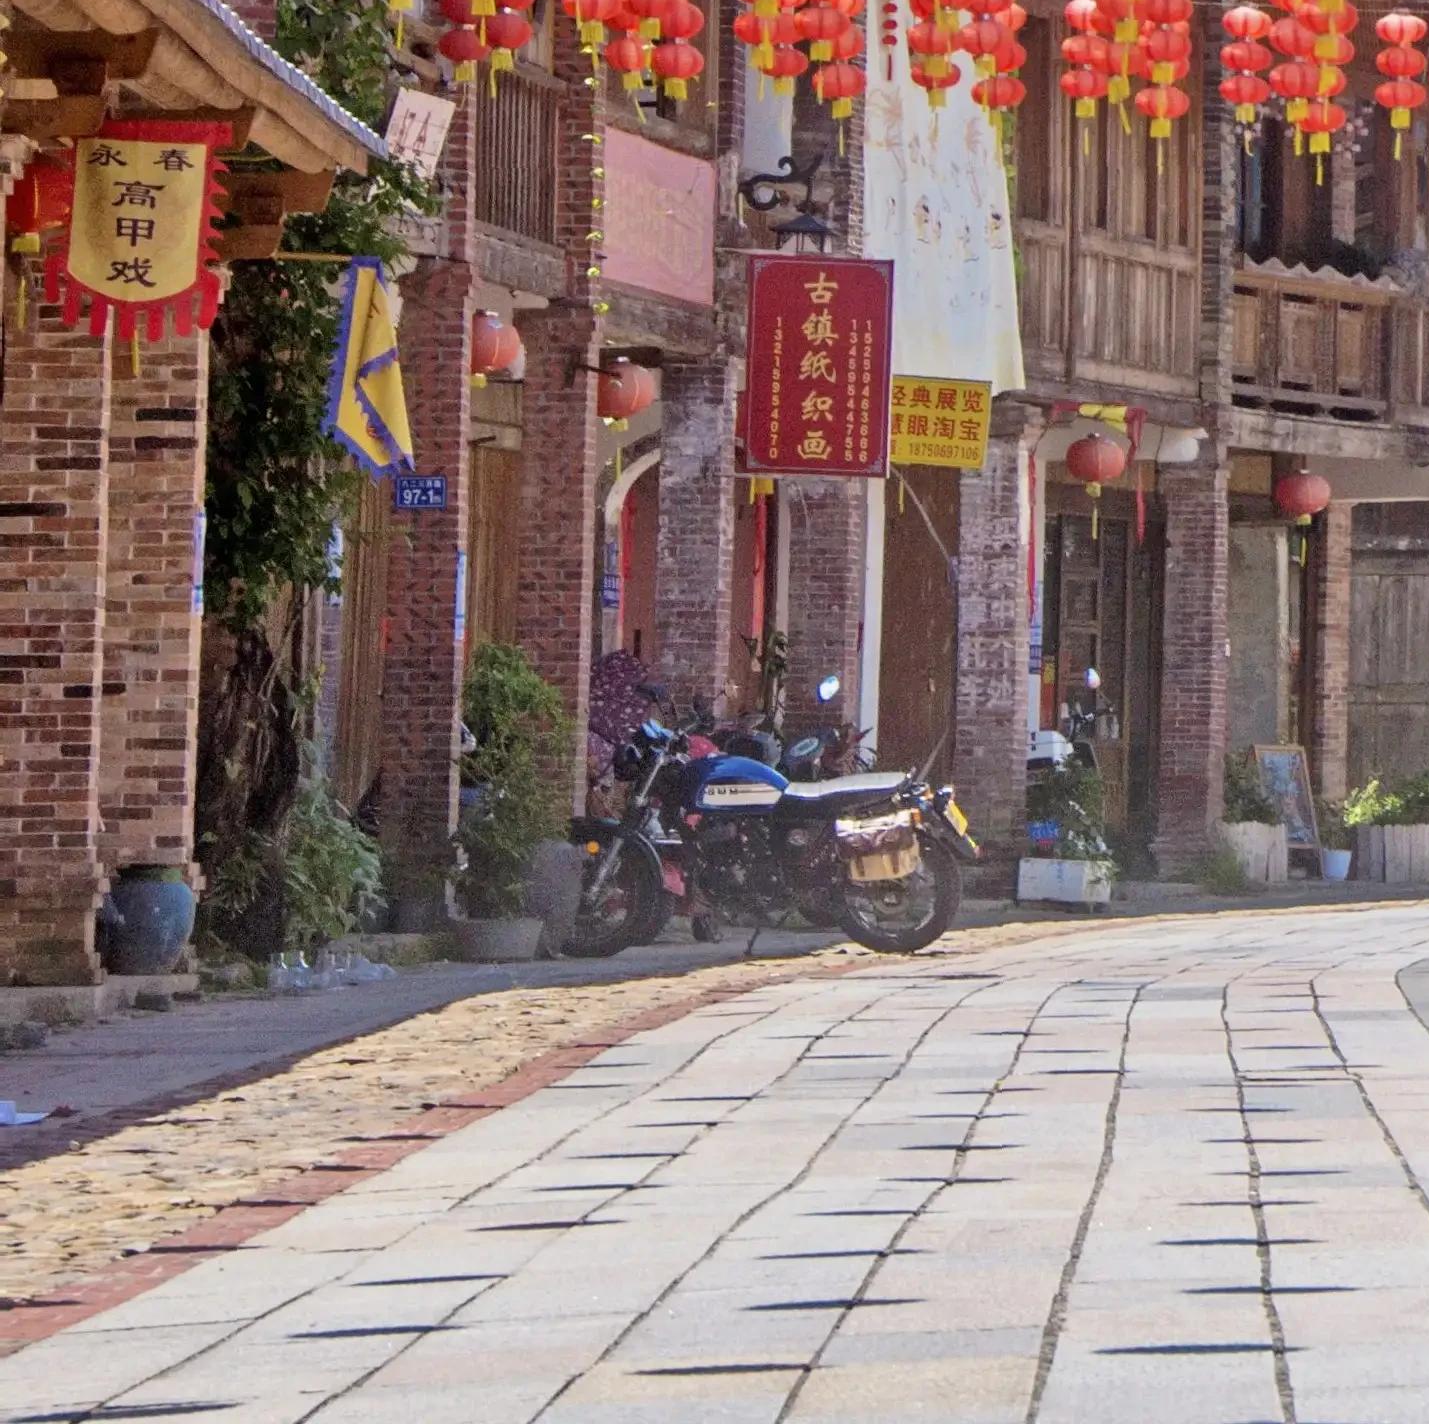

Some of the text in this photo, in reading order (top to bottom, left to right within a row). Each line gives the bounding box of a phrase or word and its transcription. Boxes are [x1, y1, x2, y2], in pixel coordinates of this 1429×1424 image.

[86, 144, 194, 173] 永春
[106, 180, 166, 288] 高甲戏
[797, 271, 840, 461] 古镇纸织画
